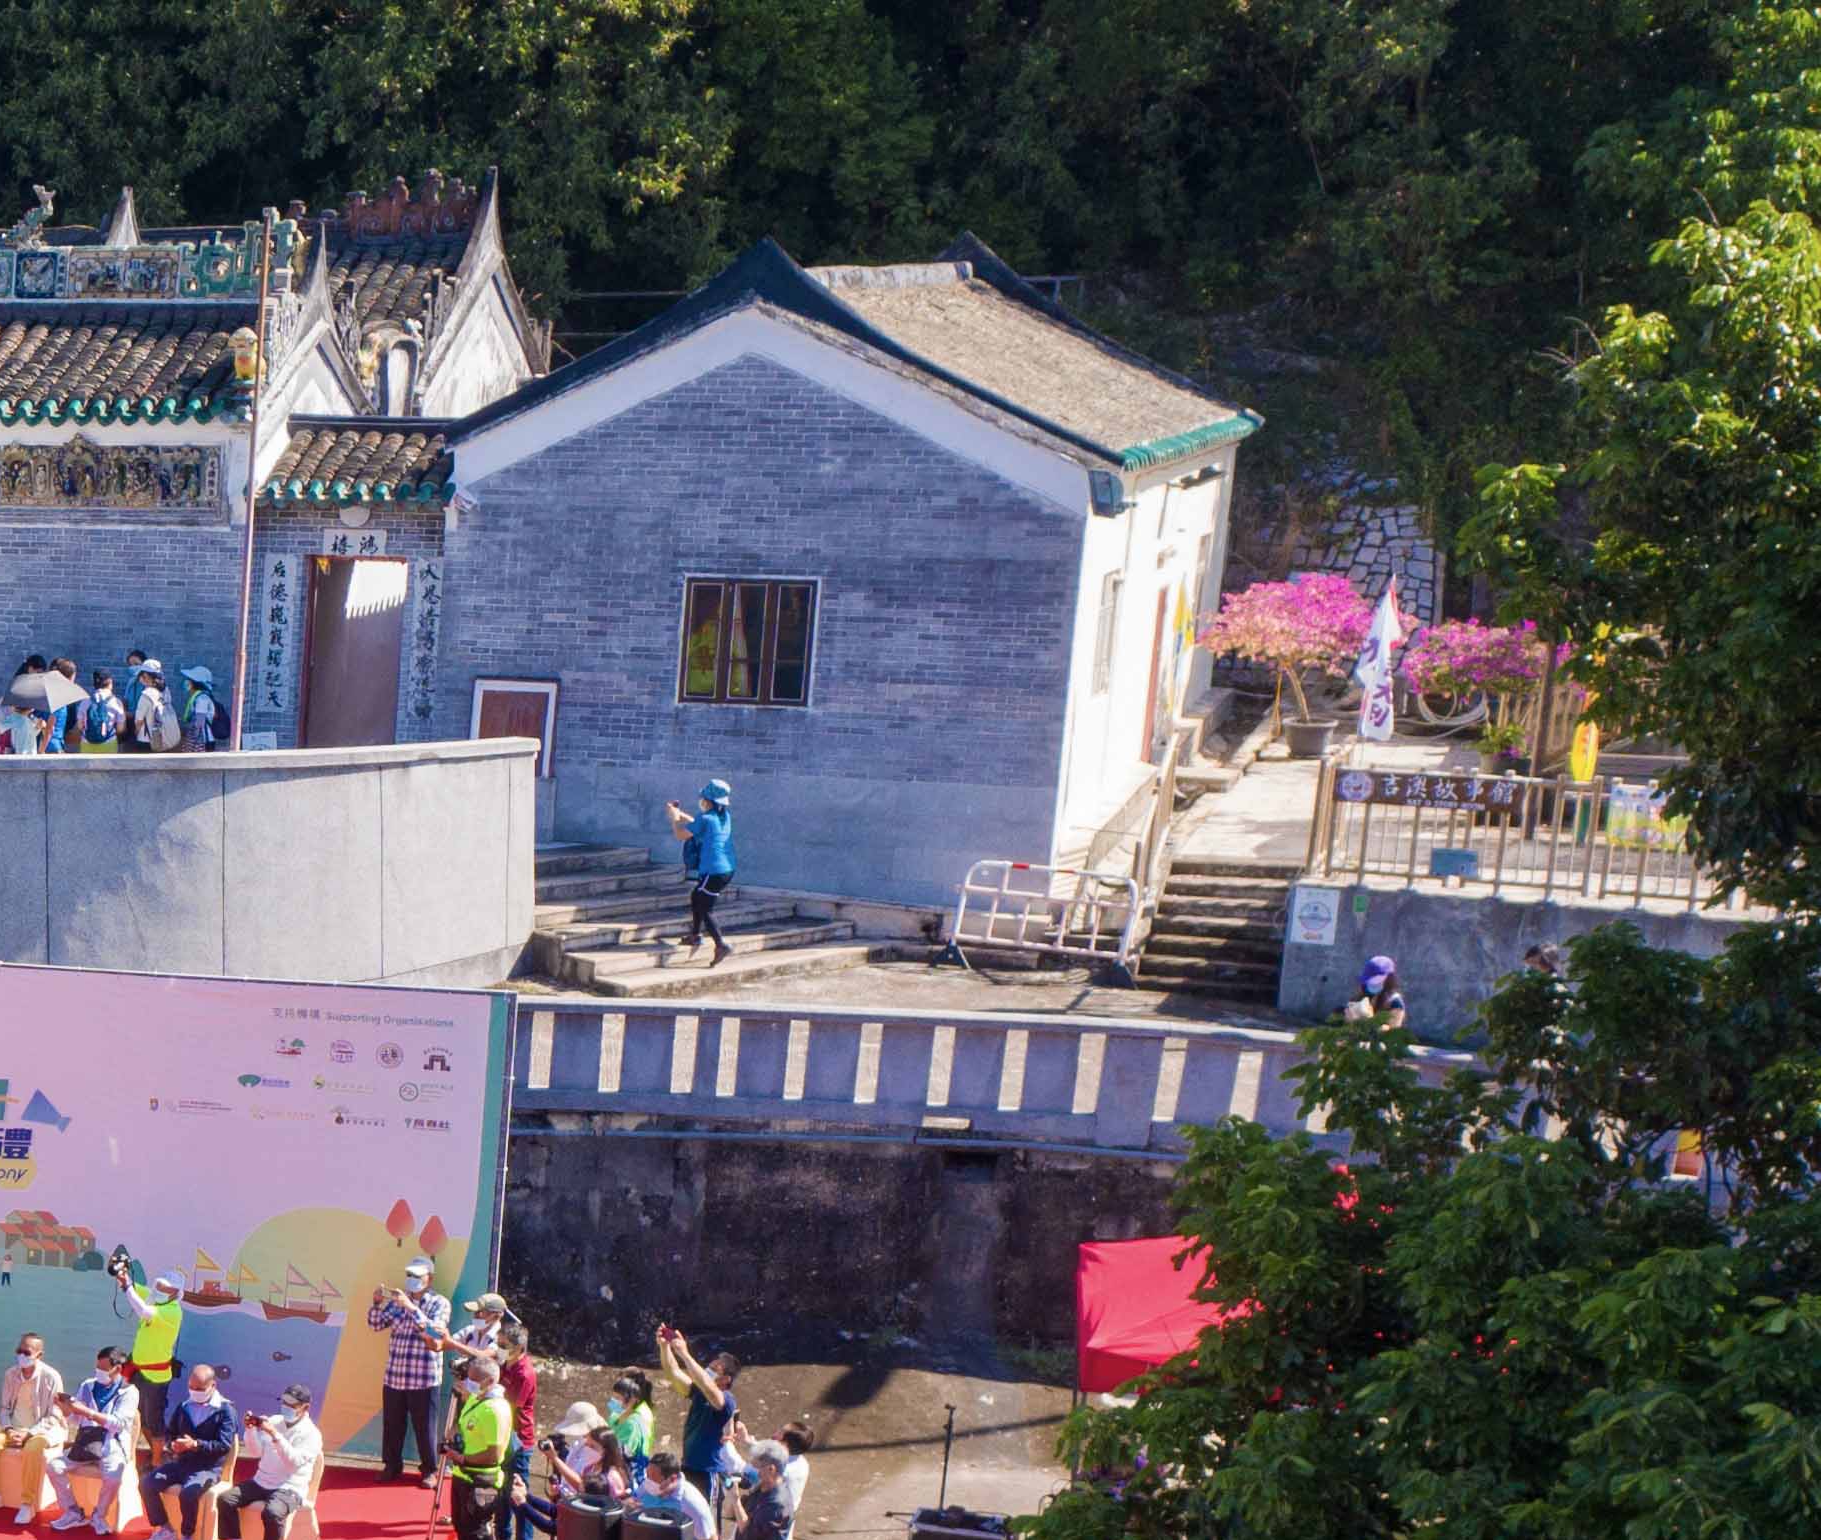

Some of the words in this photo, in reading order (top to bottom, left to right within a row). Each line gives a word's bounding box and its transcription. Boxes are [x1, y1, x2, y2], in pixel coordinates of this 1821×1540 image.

[1380, 774, 1518, 805] 吉澳故事館
